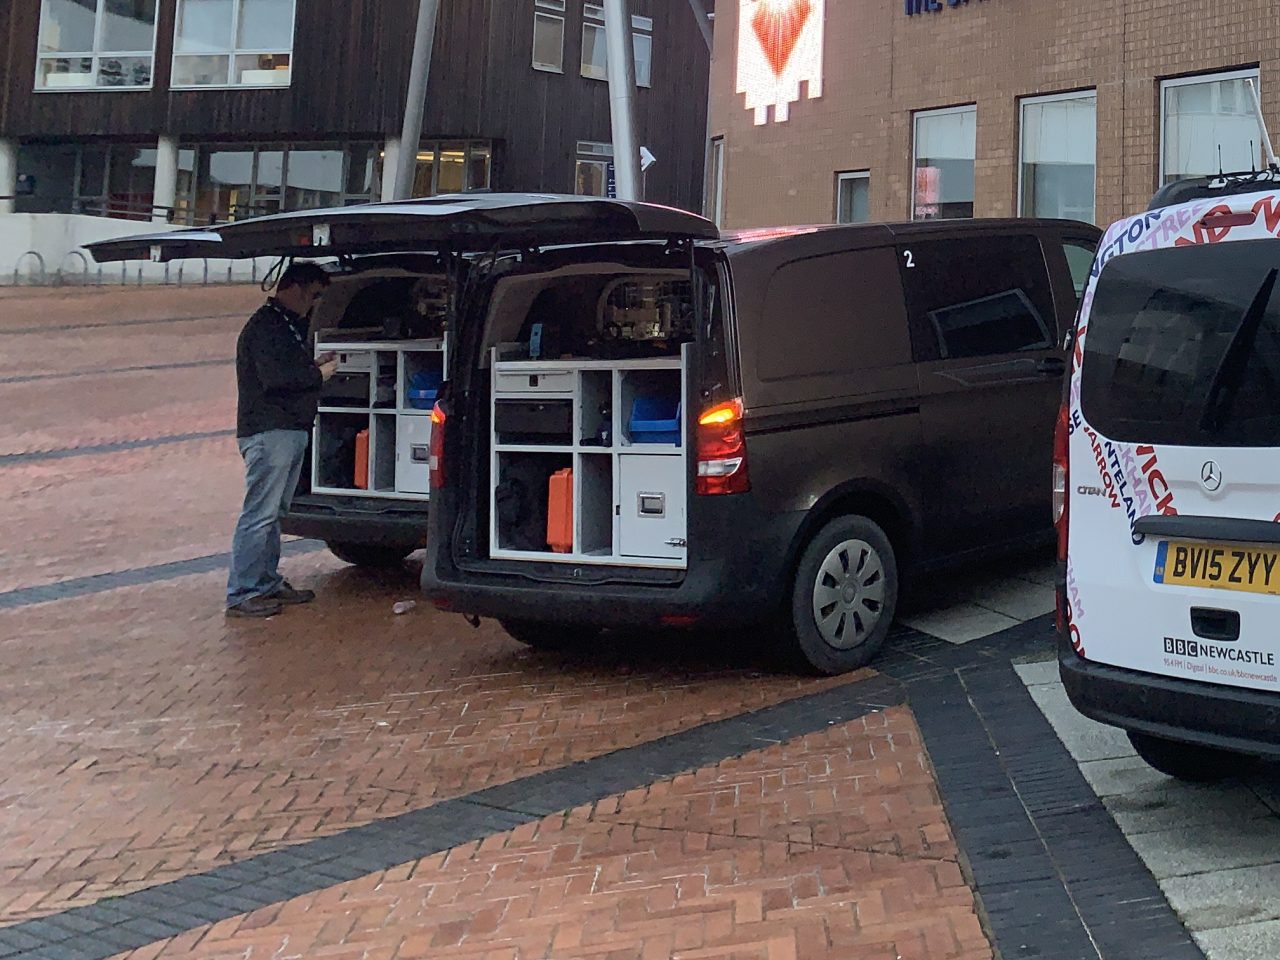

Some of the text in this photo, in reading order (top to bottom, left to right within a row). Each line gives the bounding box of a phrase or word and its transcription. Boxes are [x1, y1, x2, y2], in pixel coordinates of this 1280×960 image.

[903, 249, 915, 268] 2
[1172, 546, 1278, 586] BV15 ZYY
[1163, 637, 1275, 666] BBC NEWCASTLE
